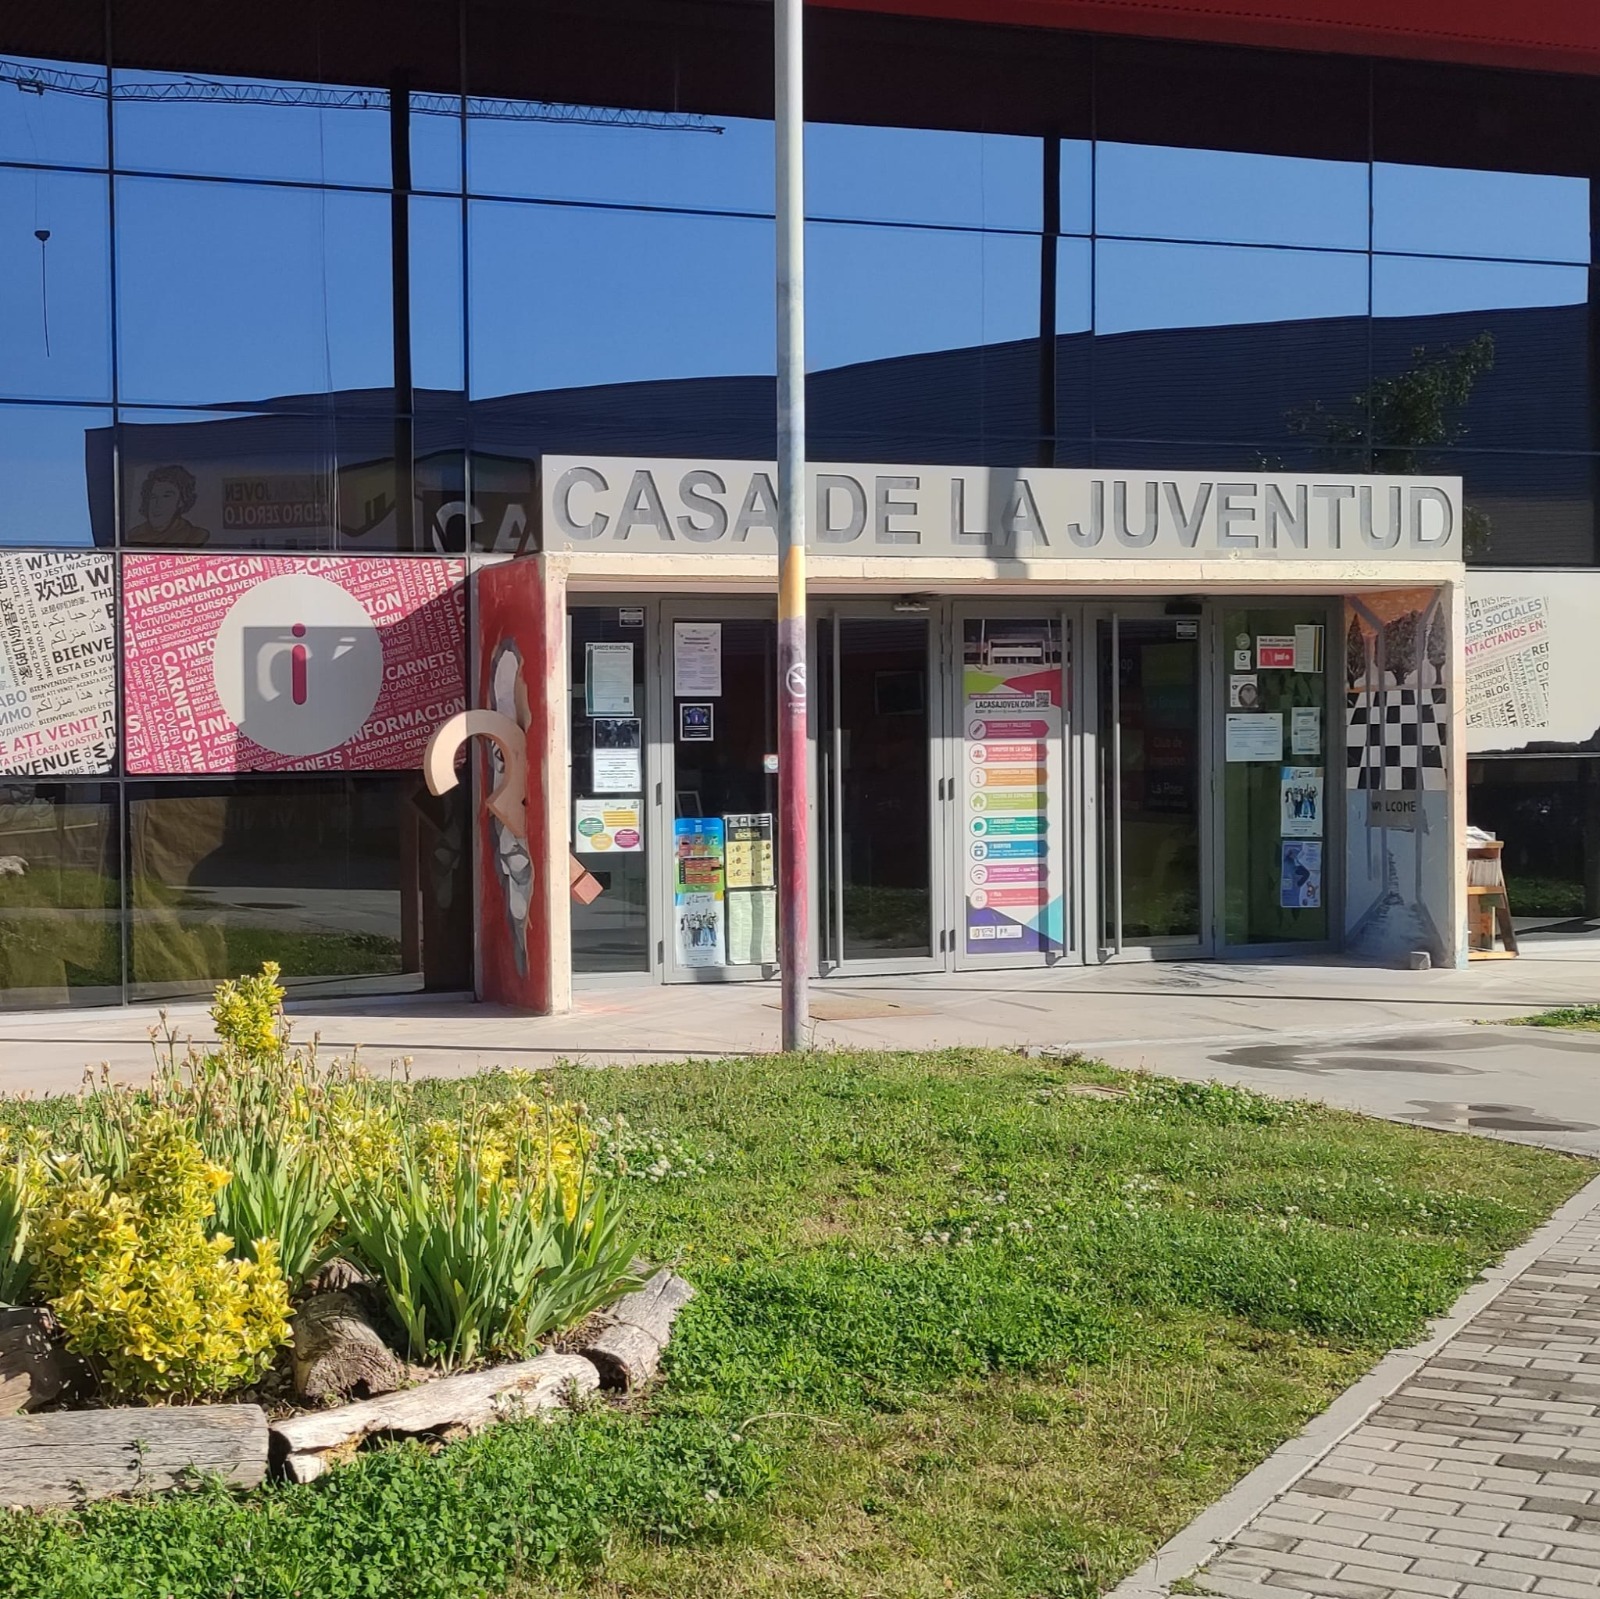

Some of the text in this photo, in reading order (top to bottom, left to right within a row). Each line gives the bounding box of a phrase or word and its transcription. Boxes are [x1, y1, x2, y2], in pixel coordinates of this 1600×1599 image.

[552, 466, 1454, 551] CASA DE LA JUVENTUD
[29, 559, 92, 581] TO JEST WASZ
[160, 559, 173, 570] DE
[358, 574, 370, 583] LA
[371, 567, 395, 580] CASA
[14, 557, 30, 597] WELCOME
[26, 598, 37, 619] THIS
[35, 630, 47, 653] YOUR
[42, 655, 54, 679] HOME
[130, 611, 138, 620] Y
[141, 588, 224, 618] ASESORAMIENTO
[134, 595, 235, 631] ACTIVIDADES CURSOS
[421, 562, 451, 650] CURSOS EMPLEO
[1486, 598, 1542, 628] SOCIALES
[135, 626, 163, 641] BECAS
[442, 599, 460, 645] JUVENIL
[138, 639, 159, 650] WIFI
[386, 650, 456, 680] CARNETS
[389, 664, 459, 692] CARNET JOVEN
[1474, 664, 1505, 681] INTERNET
[442, 675, 461, 685] CASA
[149, 655, 182, 745] CARNET JOVEN
[162, 651, 198, 742] CARNETS
[975, 701, 1035, 709] LACASAJOVEN.COM
[46, 715, 99, 742] VENIT
[355, 725, 431, 753] ASESORAMIENTO
[36, 743, 60, 757] CASA
[349, 744, 402, 766] ACTIVIDADES
